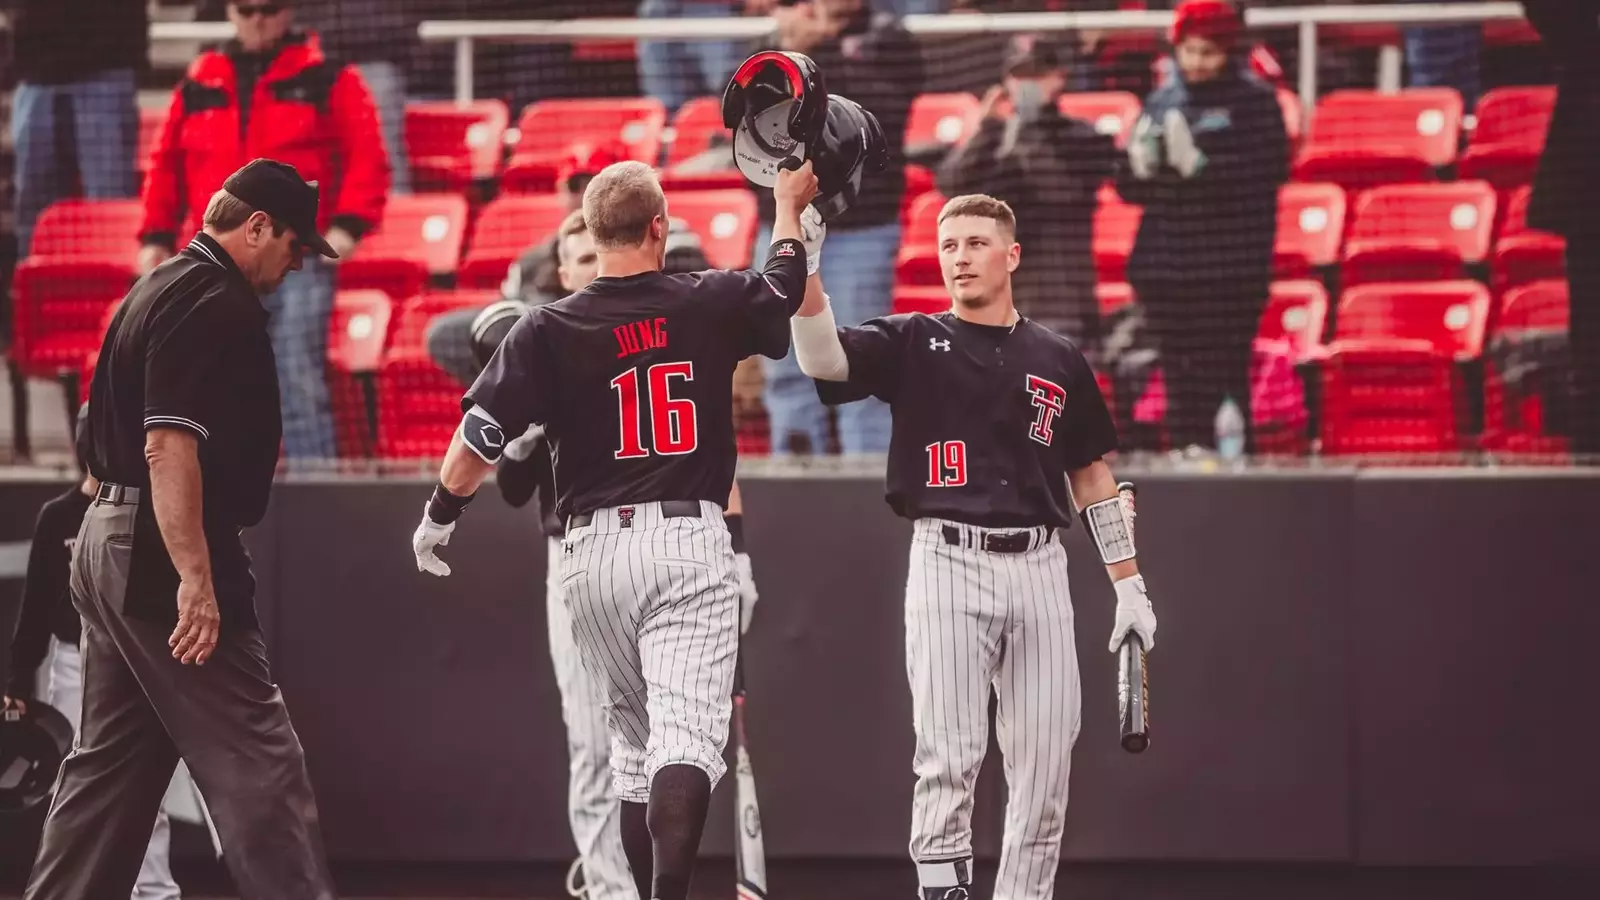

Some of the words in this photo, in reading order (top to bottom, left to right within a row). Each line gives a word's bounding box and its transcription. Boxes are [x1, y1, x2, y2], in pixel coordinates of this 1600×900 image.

[612, 317, 668, 359] JUNG
[610, 361, 698, 460] 16
[925, 440, 968, 488] 19
